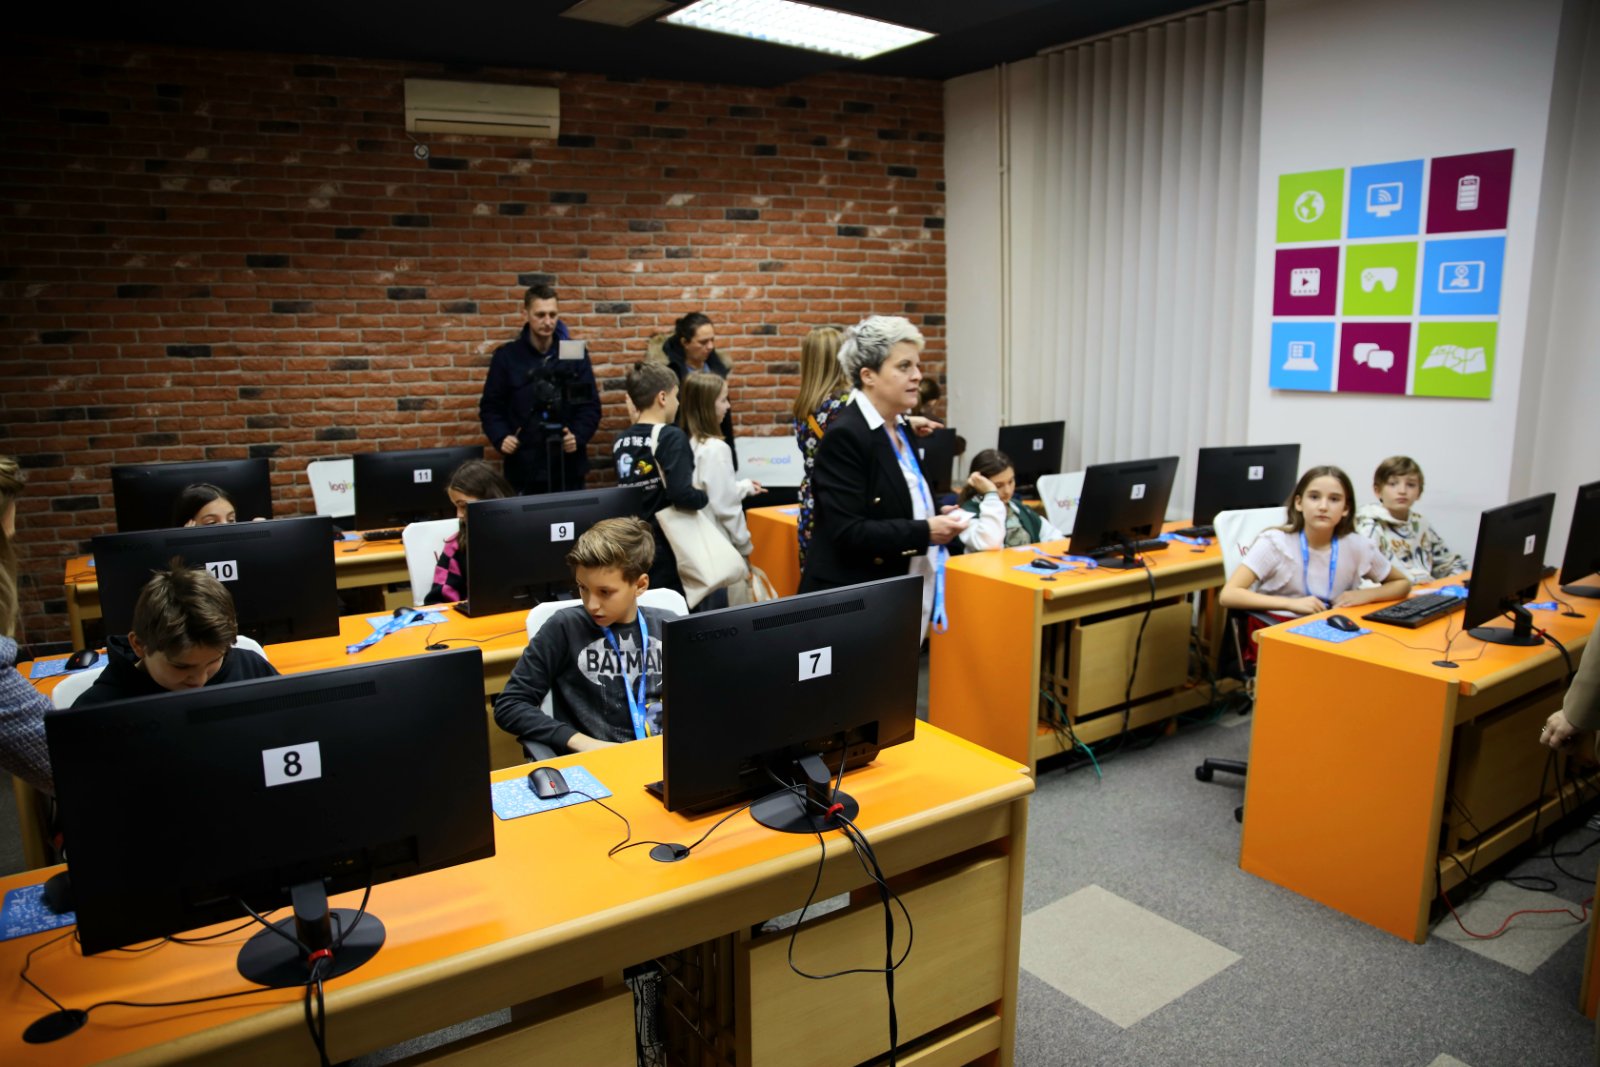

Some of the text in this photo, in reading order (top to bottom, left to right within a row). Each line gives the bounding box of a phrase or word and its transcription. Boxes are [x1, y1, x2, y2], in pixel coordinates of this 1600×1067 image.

[418, 471, 429, 481] 11
[558, 526, 567, 538] 9
[211, 564, 233, 579] 10
[809, 653, 821, 674] 7
[283, 750, 302, 777] 8
